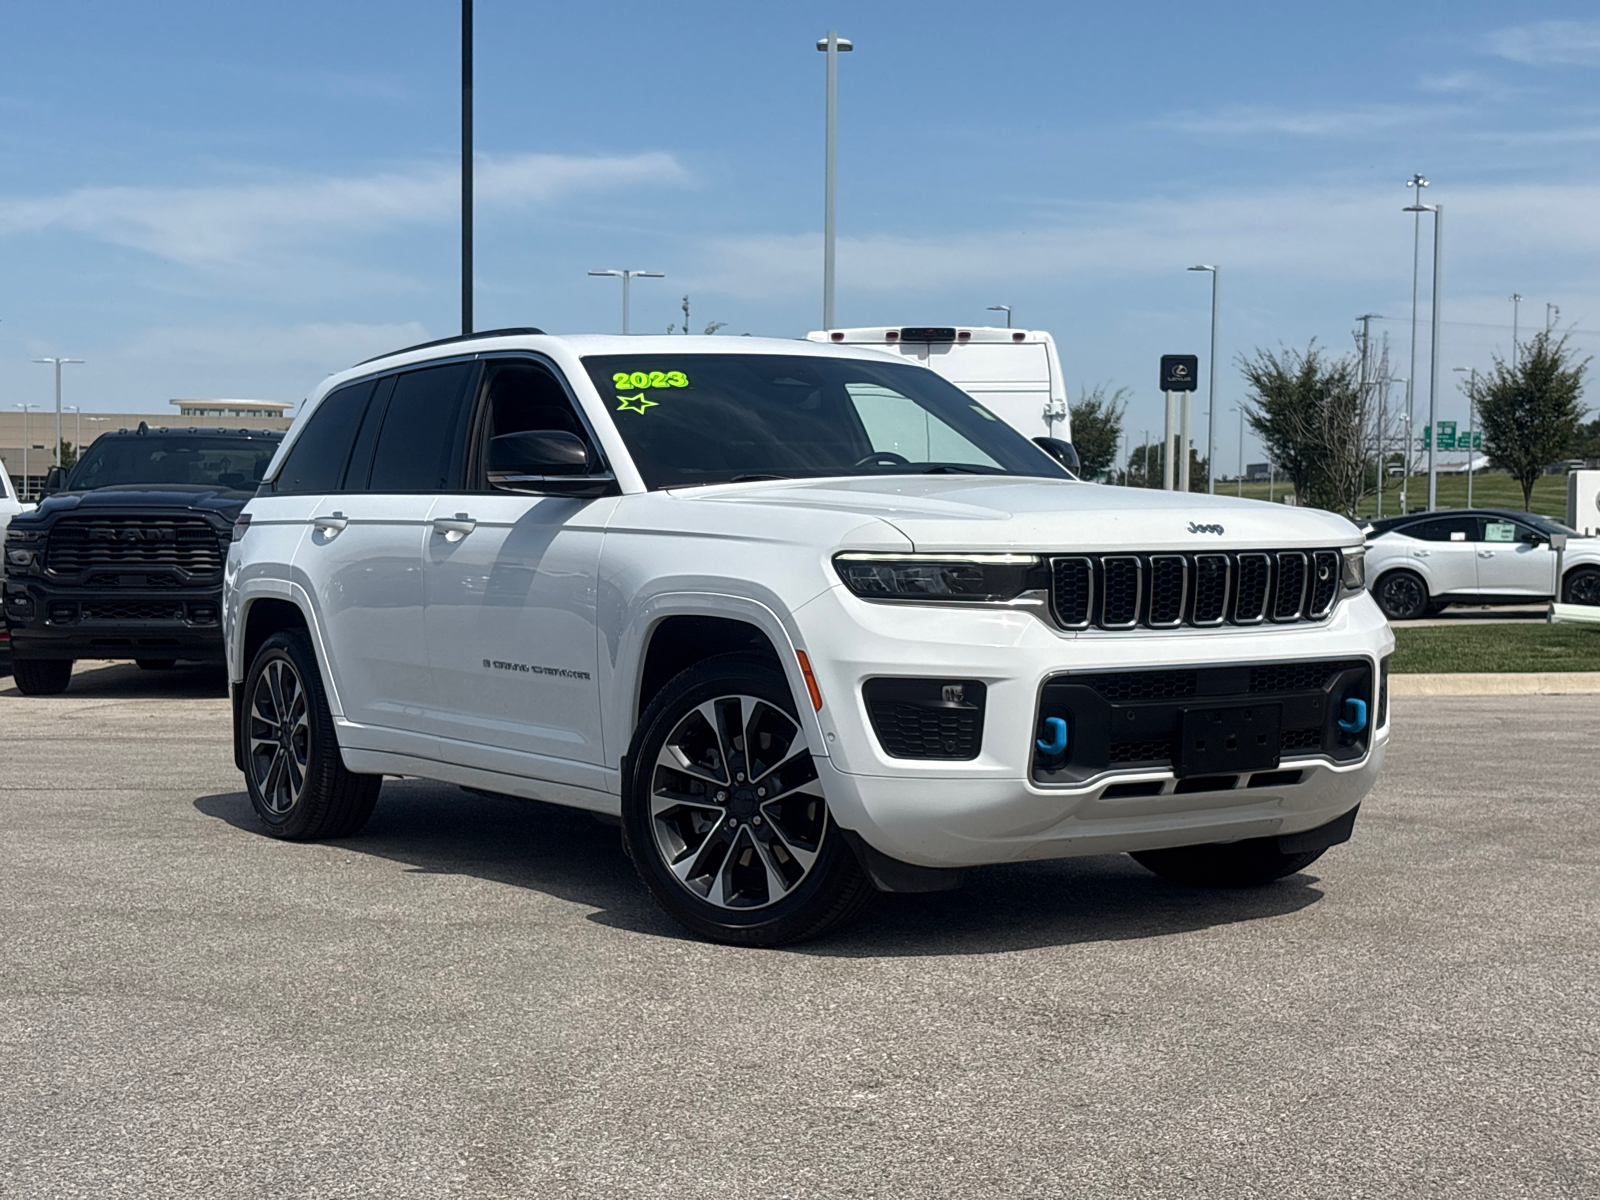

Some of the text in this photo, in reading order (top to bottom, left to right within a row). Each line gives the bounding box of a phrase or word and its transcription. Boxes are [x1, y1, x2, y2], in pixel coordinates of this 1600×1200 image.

[612, 370, 690, 390] 2023
[89, 527, 176, 541] RAM
[1187, 521, 1225, 536] Jeep
